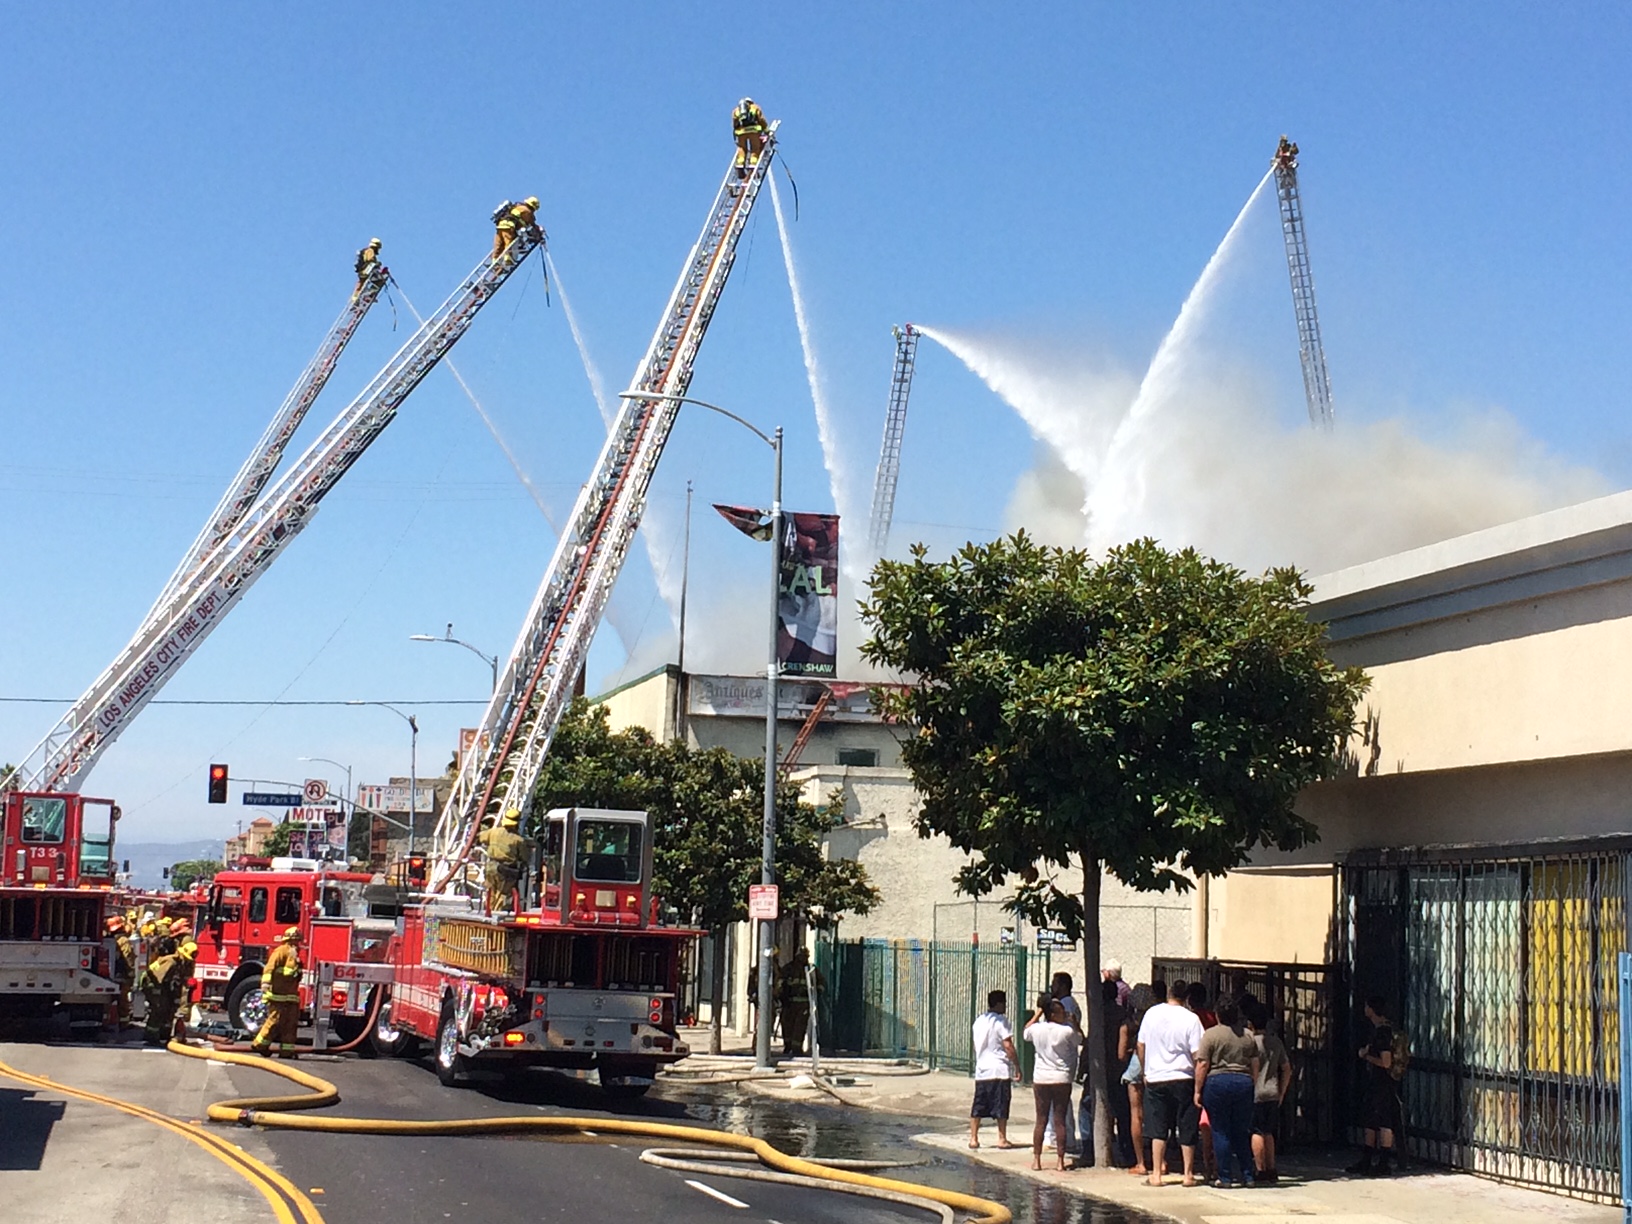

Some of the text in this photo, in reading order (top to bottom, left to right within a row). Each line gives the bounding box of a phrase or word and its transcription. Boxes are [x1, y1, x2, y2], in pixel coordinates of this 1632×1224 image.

[98, 704, 122, 728] LOS
[119, 661, 159, 707] ANGELES
[156, 639, 180, 665] CITY
[177, 616, 200, 642] FIRE
[782, 661, 834, 674] CRENSHAW
[703, 681, 764, 700] Antiques
[246, 795, 267, 804] Hyde
[293, 807, 336, 821] MOTE
[334, 965, 357, 979] 64
